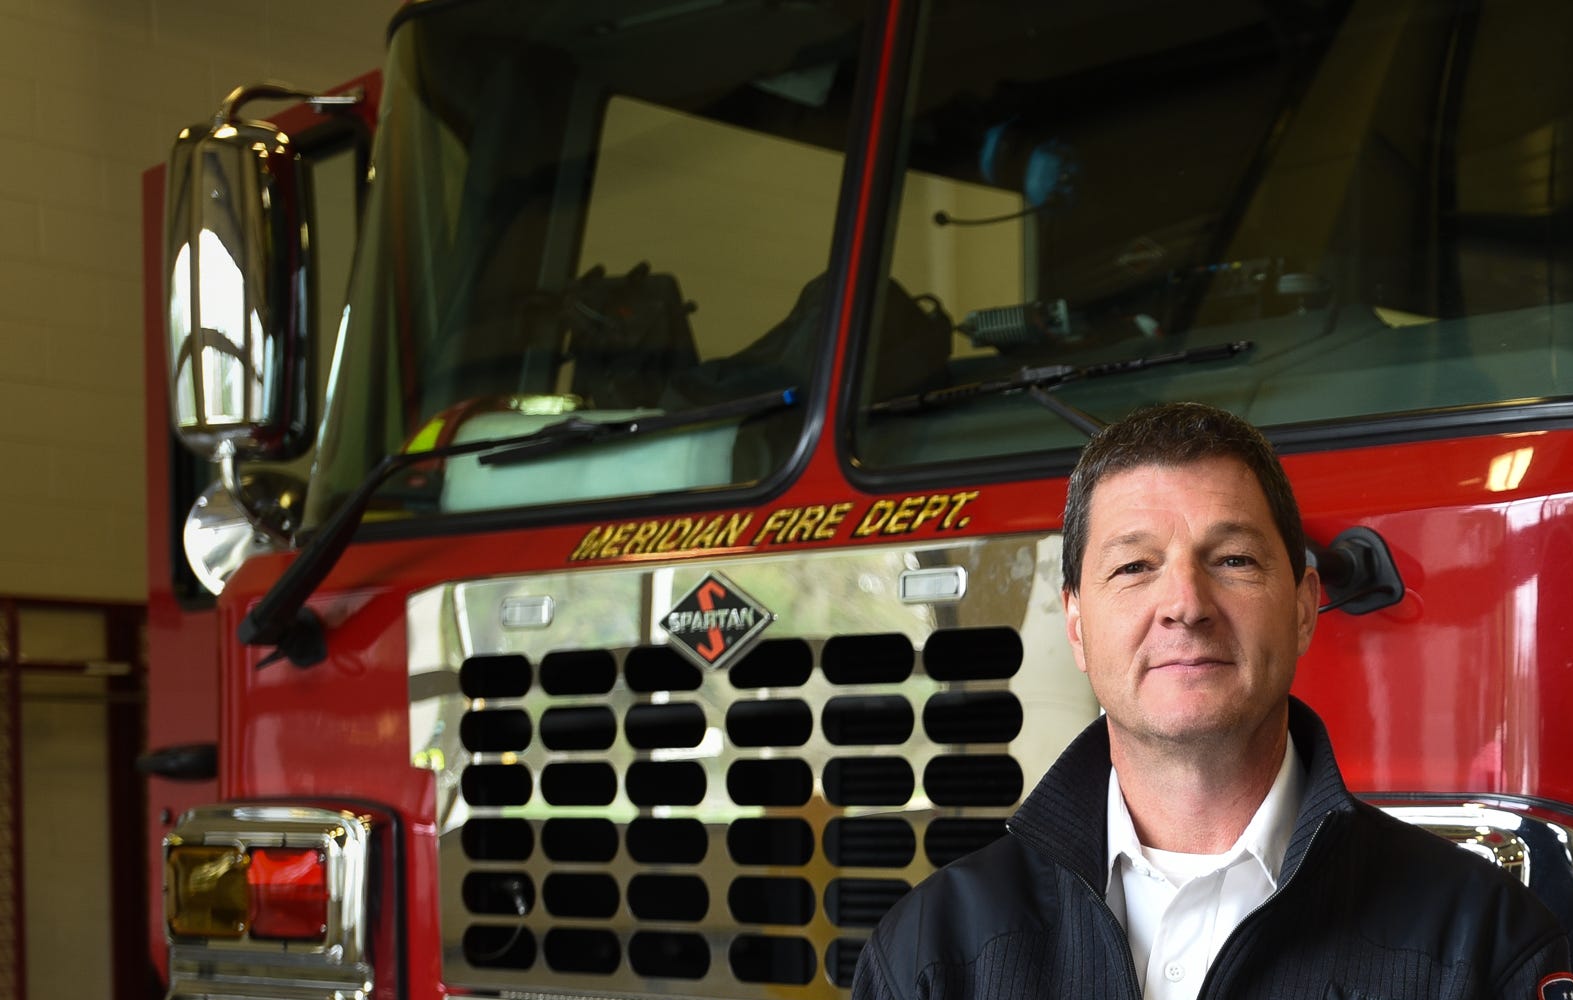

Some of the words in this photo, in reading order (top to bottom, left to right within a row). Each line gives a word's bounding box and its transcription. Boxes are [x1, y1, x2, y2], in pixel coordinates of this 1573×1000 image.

[569, 511, 754, 561] MERIDIAN
[752, 502, 853, 546] FIRE
[852, 491, 980, 537] DEPT.
[668, 607, 755, 634] SPARTAN
